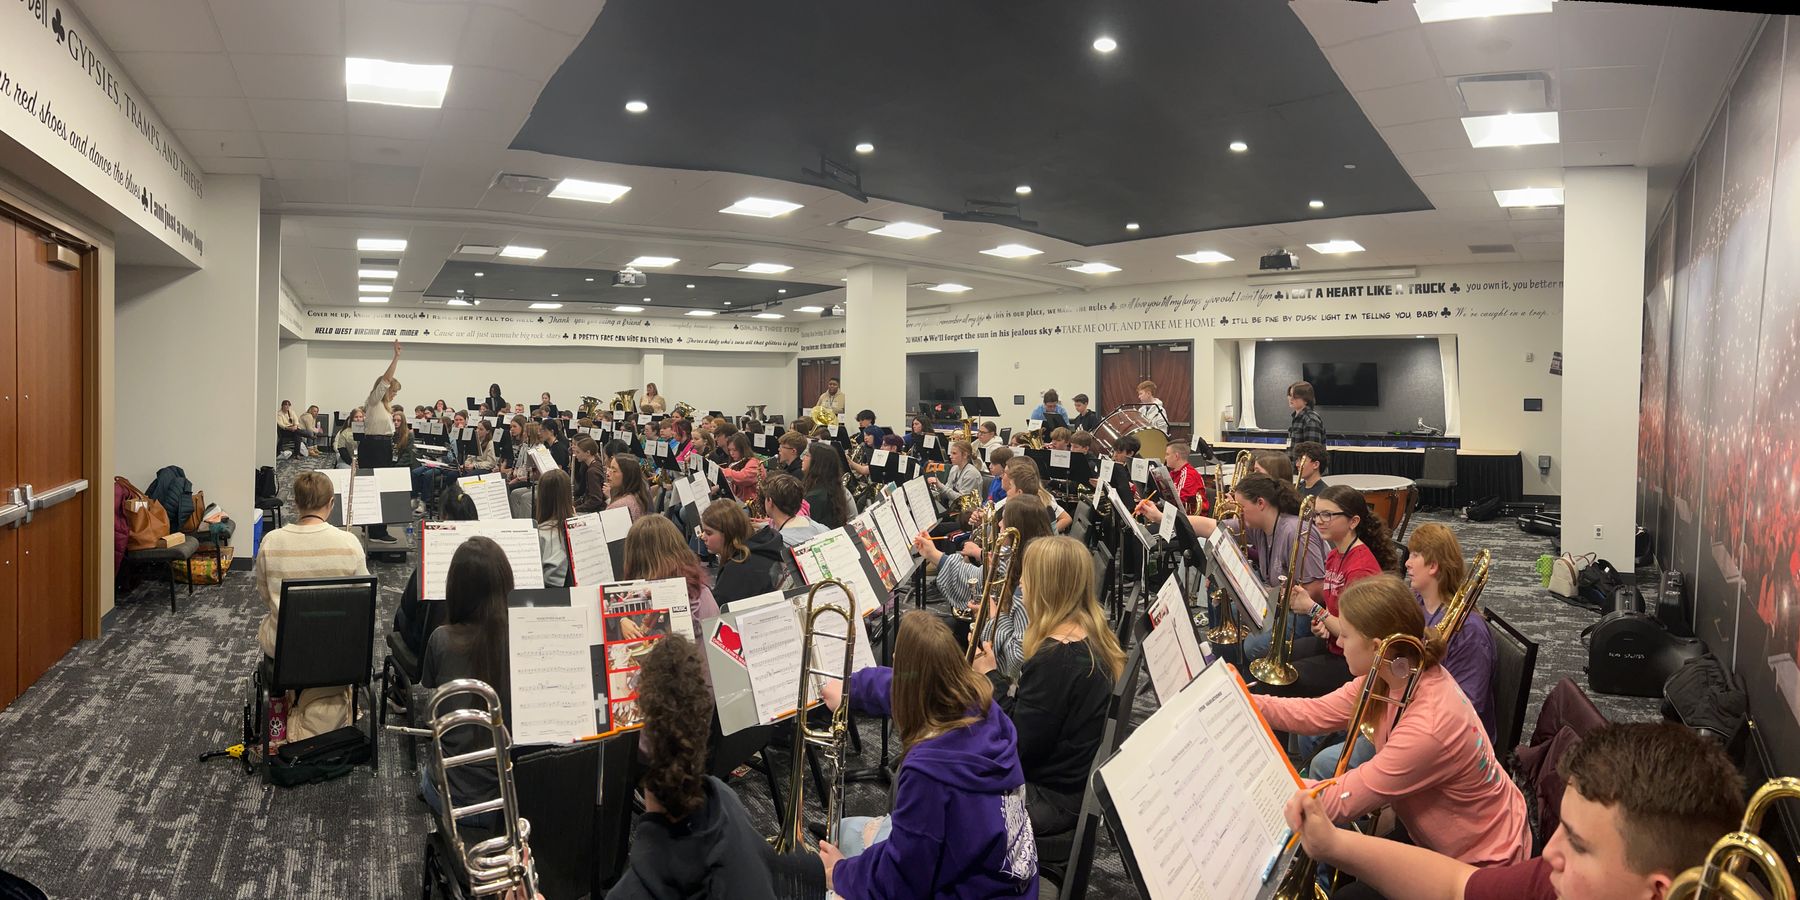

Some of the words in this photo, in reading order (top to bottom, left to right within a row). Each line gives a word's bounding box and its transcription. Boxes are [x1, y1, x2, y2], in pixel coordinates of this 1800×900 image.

[68, 30, 123, 112] GYPSIES,
[125, 92, 163, 155] TRAMPS,
[162, 141, 180, 171] AND
[180, 159, 204, 199] THIEVES
[14, 82, 38, 117] red
[39, 101, 70, 141] shoes
[70, 131, 89, 158] and
[89, 142, 113, 177] dance
[112, 161, 126, 186] the
[125, 170, 143, 200] blues
[154, 201, 165, 224] am
[165, 203, 178, 231] just
[182, 222, 195, 246] poor
[194, 230, 204, 257] boy
[1315, 287, 1324, 299] A
[1326, 286, 1364, 298] HEART
[1366, 284, 1392, 297] LIKE
[1408, 282, 1446, 295] TRUCK
[1466, 282, 1481, 293] you
[1482, 282, 1500, 290] own
[1512, 281, 1528, 292] you
[1529, 279, 1557, 289] better
[1295, 314, 1317, 322] DUSK
[1321, 313, 1342, 321] LIGHT
[1416, 310, 1438, 318] BABY
[1061, 325, 1082, 334] TAKE
[1083, 324, 1097, 333] ME
[1120, 321, 1142, 331] AND
[1142, 320, 1167, 331] TAKE
[1168, 319, 1183, 329] ME
[1185, 318, 1216, 328] HOME
[578, 333, 599, 341] PRETTY
[600, 334, 614, 342] FACE
[944, 333, 963, 342] forget
[965, 331, 975, 339] the
[977, 331, 989, 339] sun
[990, 330, 999, 338] in
[999, 329, 1010, 337] his
[1011, 328, 1038, 338] jealous
[1039, 327, 1053, 336] sky
